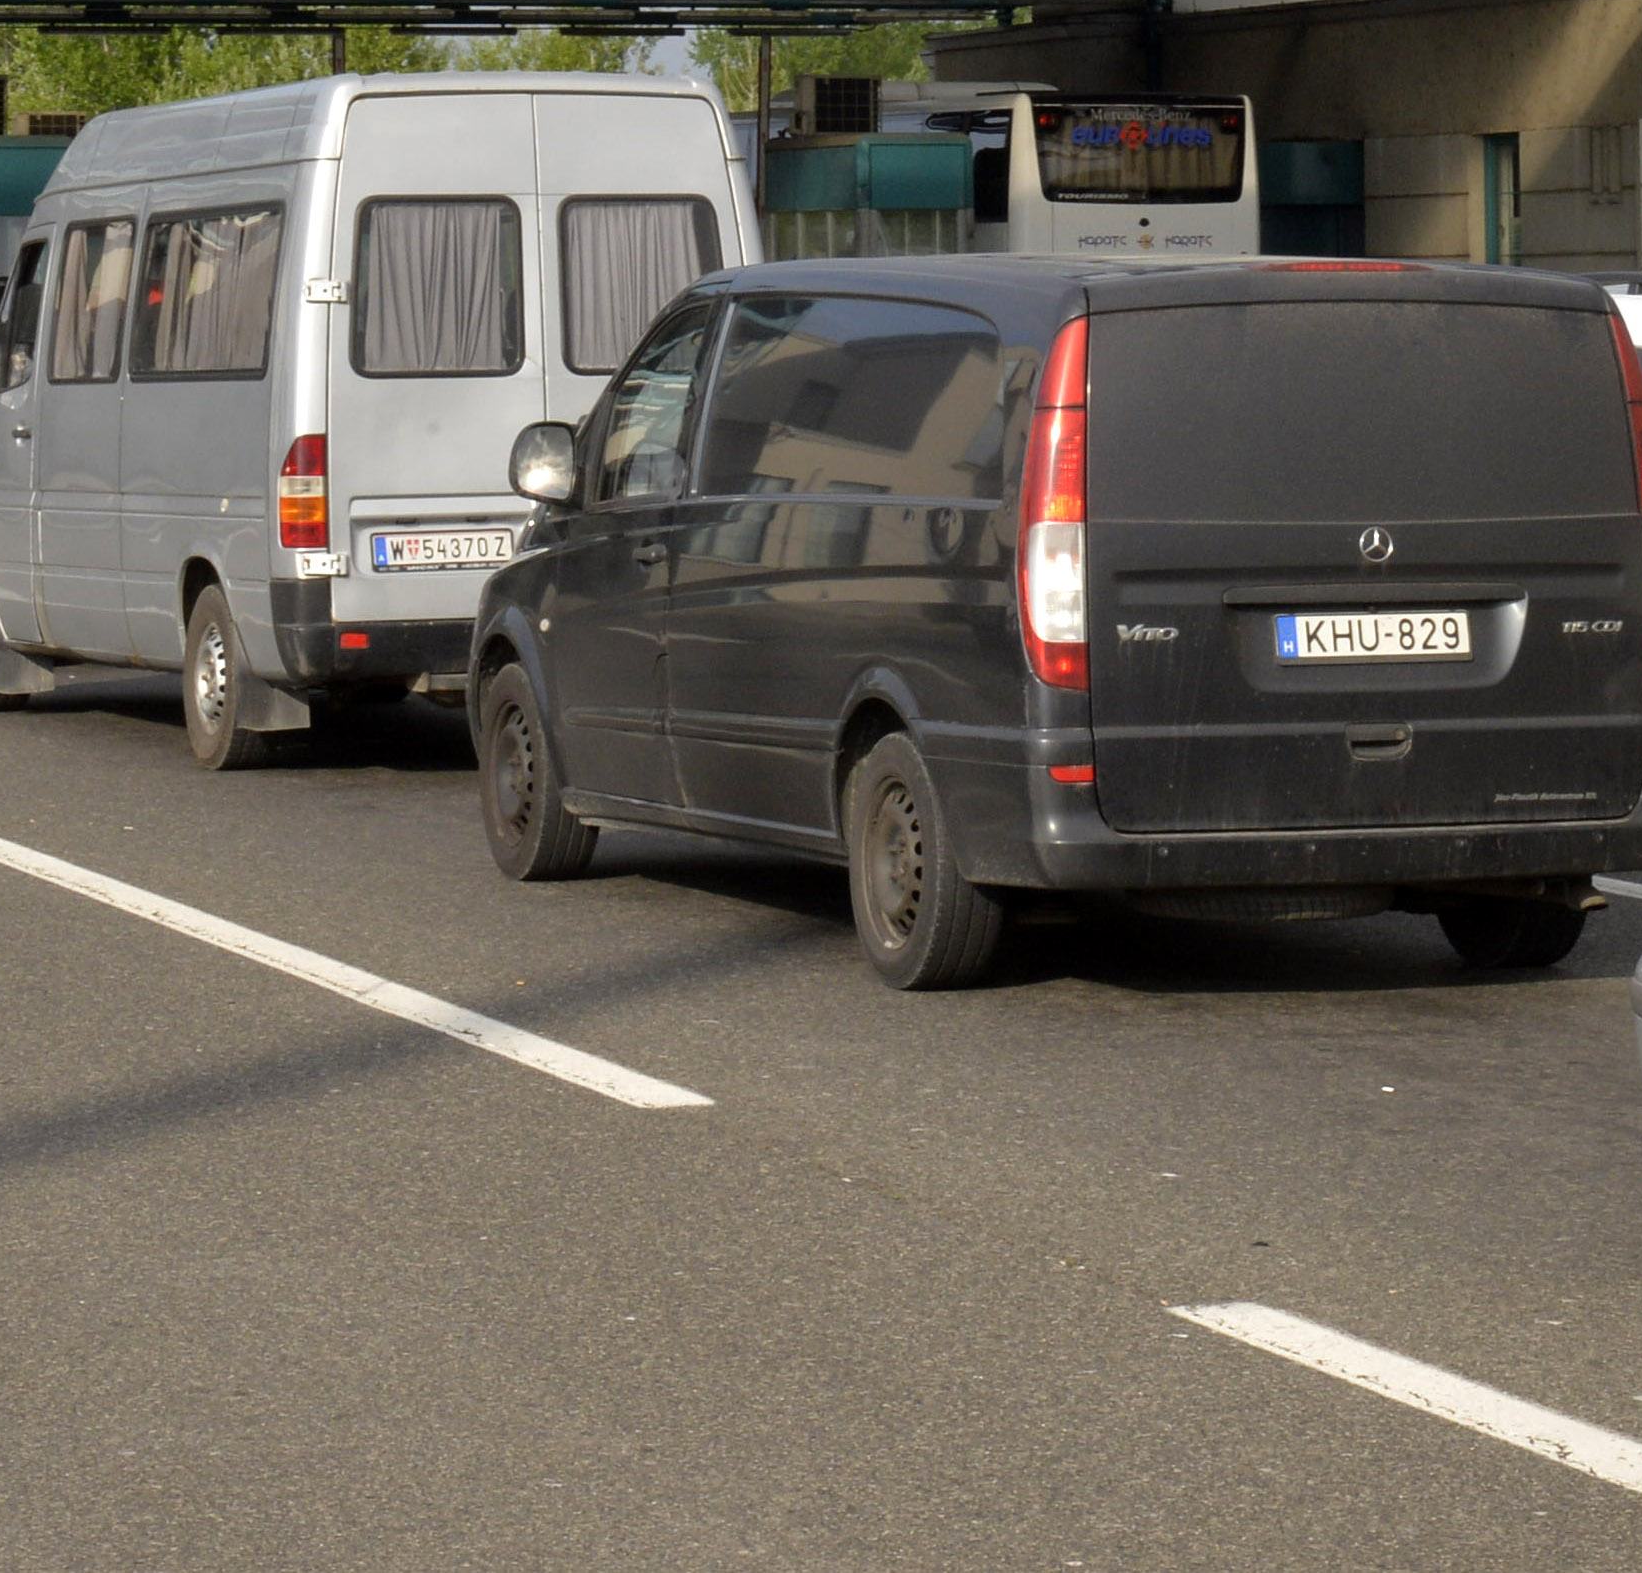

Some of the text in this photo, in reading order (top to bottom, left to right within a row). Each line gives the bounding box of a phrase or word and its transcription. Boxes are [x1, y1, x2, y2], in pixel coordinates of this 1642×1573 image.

[1090, 108, 1191, 122] Mercedes-Benz
[390, 536, 506, 560] W 54370 Z
[1305, 617, 1460, 653] KHU-829
[1283, 641, 1294, 653] H
